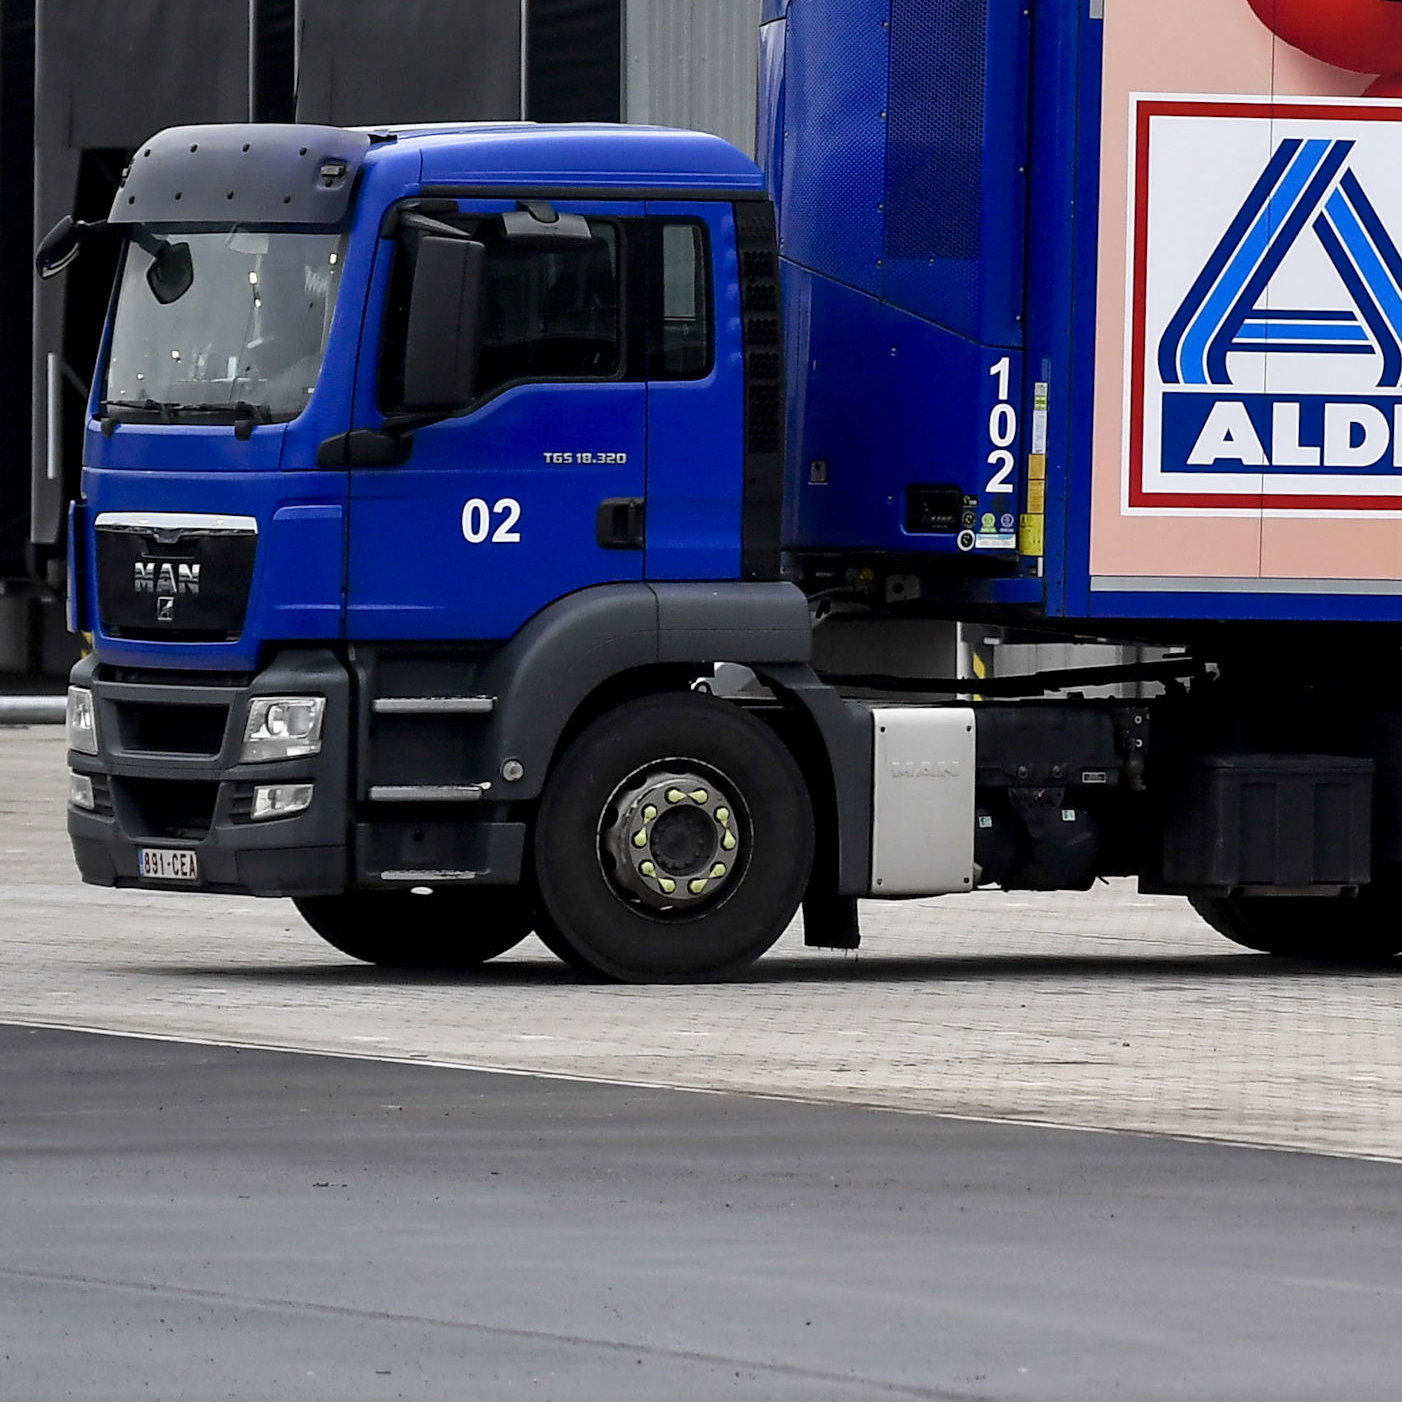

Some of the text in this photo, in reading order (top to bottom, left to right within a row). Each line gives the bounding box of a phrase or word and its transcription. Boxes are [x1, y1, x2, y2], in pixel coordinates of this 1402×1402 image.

[543, 452, 627, 464] TGS 18.320
[461, 498, 521, 544] 02
[134, 562, 201, 593] MAN
[892, 761, 960, 778] MAN
[144, 852, 196, 877] 891-CEA
